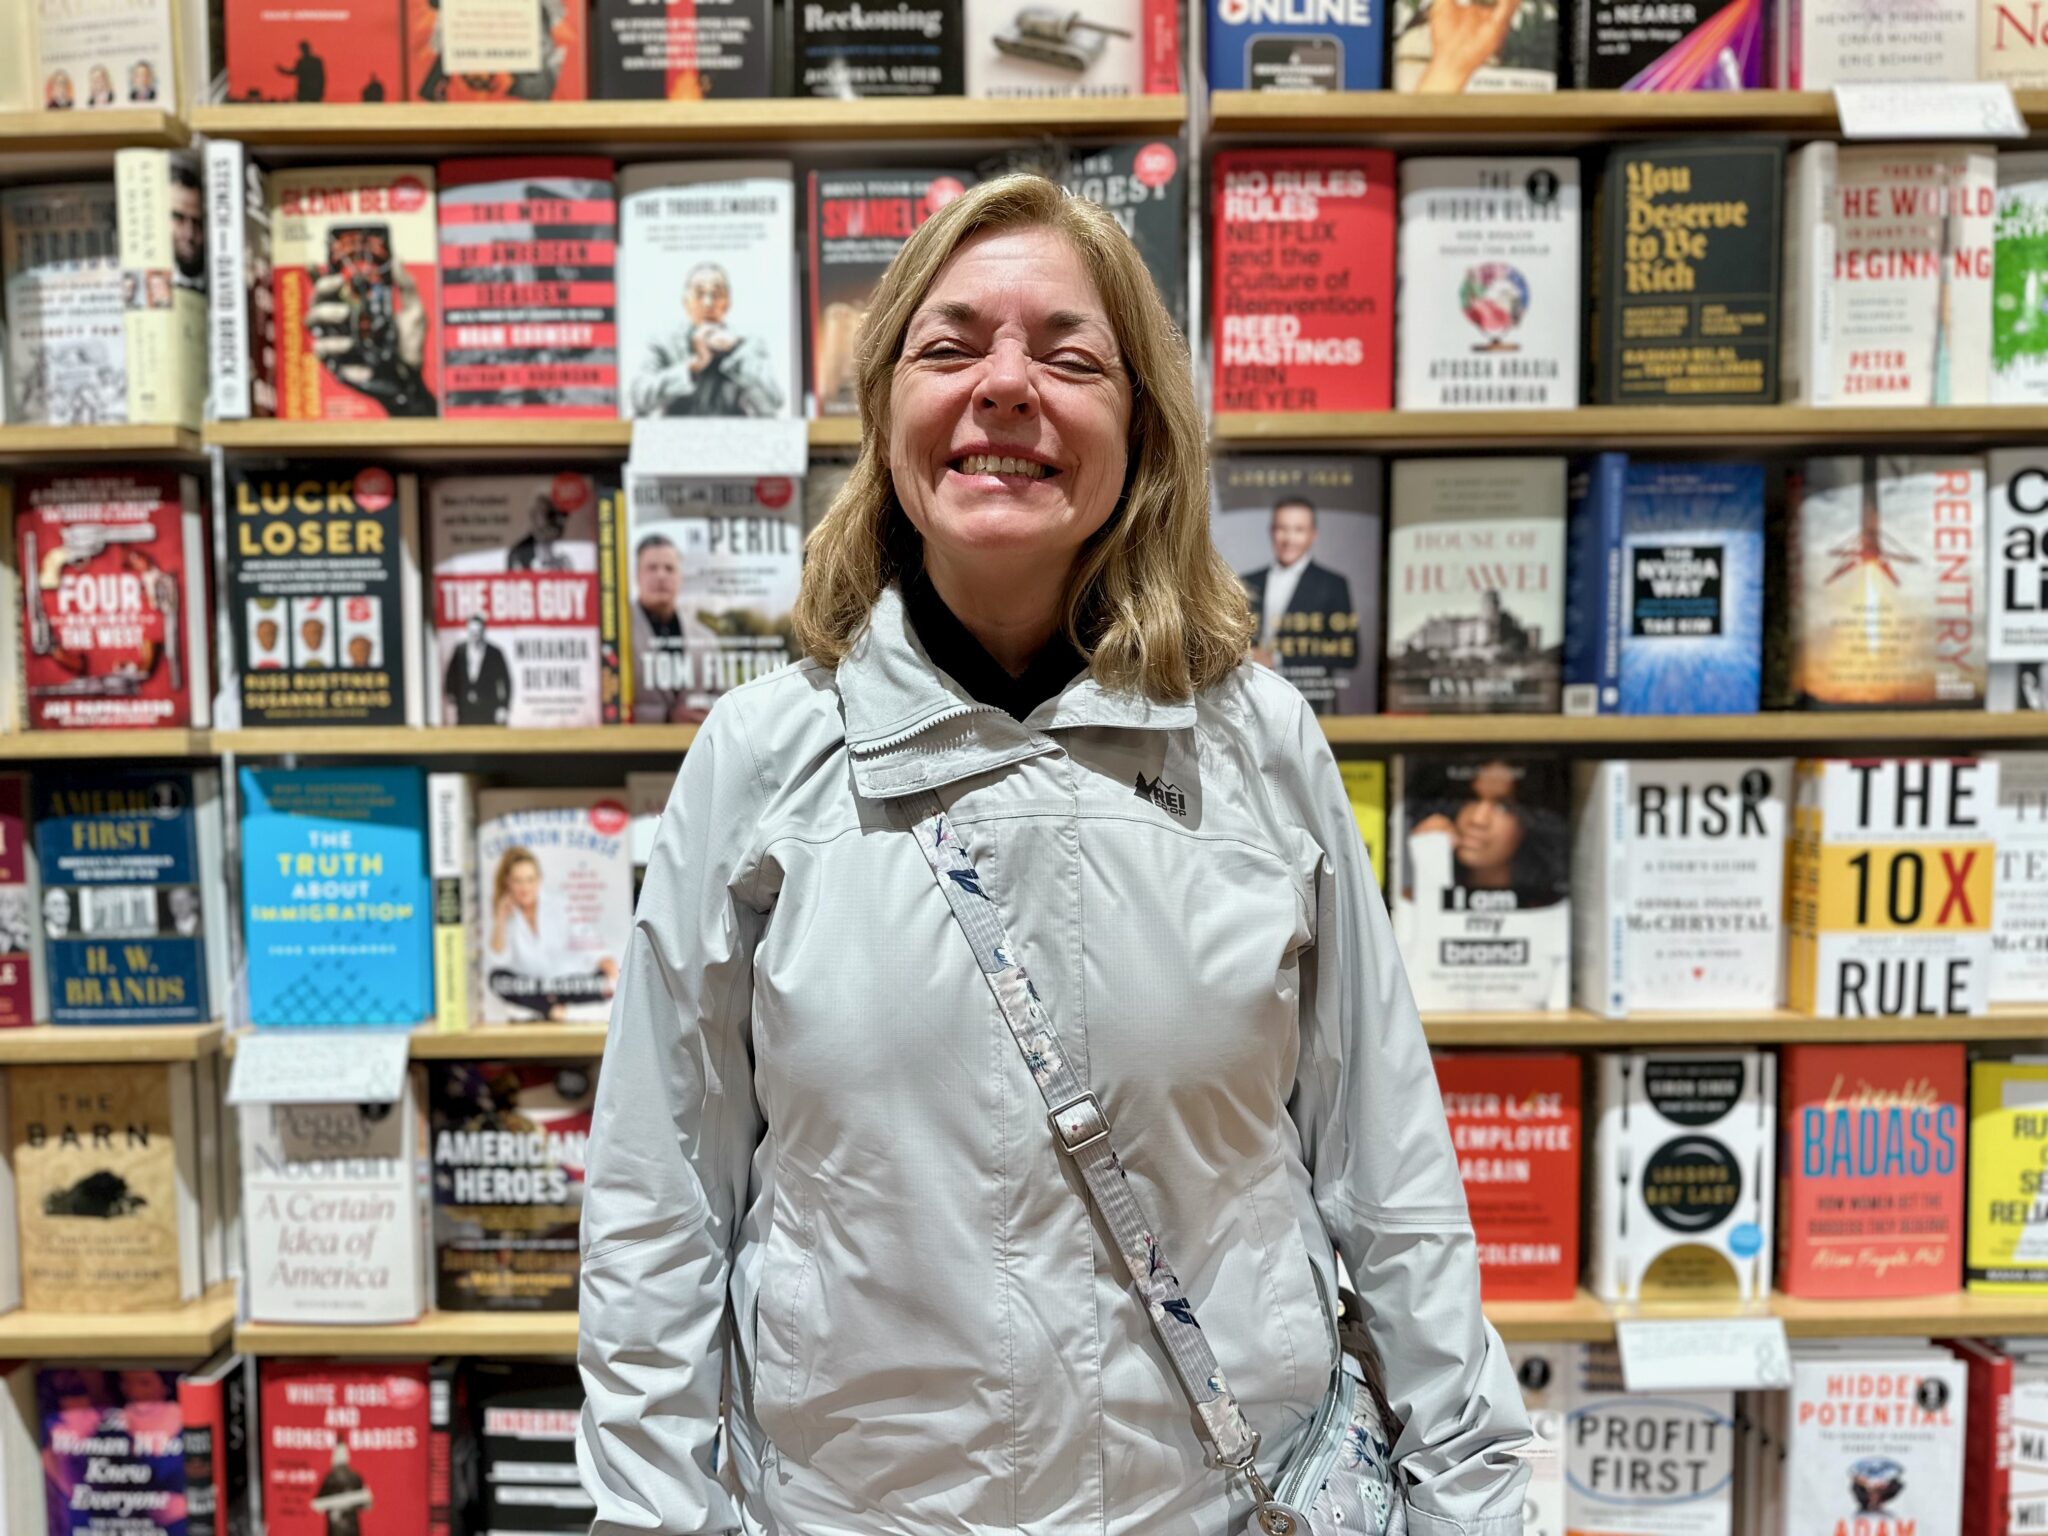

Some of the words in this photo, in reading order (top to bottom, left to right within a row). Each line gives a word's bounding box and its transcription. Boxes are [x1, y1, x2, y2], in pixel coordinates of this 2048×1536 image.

[804, 3, 943, 38] Reckoning
[1218, 0, 1372, 26] ONLINE
[1614, 3, 1697, 24] NEARER
[212, 157, 236, 228] STENCH
[1225, 170, 1268, 198] NO
[1272, 170, 1367, 198] RULES
[1479, 170, 1512, 191] THE
[1625, 161, 1692, 200] You
[281, 187, 353, 218] GLENN
[472, 205, 506, 222] THE
[517, 204, 574, 222] MYTH
[635, 199, 661, 219] THE
[667, 196, 780, 216] TROUBLEMAKER
[1224, 196, 1320, 222] RULES
[1426, 199, 1496, 223] HIDDEN
[1625, 199, 1749, 232] Deserve
[1225, 221, 1337, 244] NETFLIX
[1226, 247, 1275, 268] and
[1280, 247, 1321, 268] the
[1626, 233, 1660, 263] to
[1663, 229, 1708, 261] Be
[213, 256, 238, 312] DAVID
[1226, 269, 1318, 291] Culture
[1325, 268, 1351, 290] of
[1624, 260, 1696, 294] Rich
[1226, 294, 1376, 315] Reinvention
[511, 325, 594, 346] CHOMSKY
[1223, 315, 1301, 338] REED
[216, 317, 239, 376] BROCK
[1222, 338, 1364, 366] HASTINGS
[1849, 350, 1907, 371] PETER
[1224, 366, 1286, 386] ERIN
[1844, 374, 1912, 395] ZEIHAN
[1224, 387, 1317, 409] MEYER
[1228, 469, 1303, 487] ROBERT
[236, 480, 374, 515] LUCK
[238, 519, 385, 556] LOSER
[709, 520, 792, 556] PERIL
[1413, 529, 1497, 550] HOUSE
[1506, 528, 1540, 549] OF
[1404, 562, 1549, 595] HUAWEI
[1636, 559, 1720, 581] NVIDIA
[1934, 469, 1975, 674] REENTRY
[57, 573, 143, 613] FOUR
[441, 580, 489, 622] THE
[491, 579, 535, 621] BIG
[537, 579, 590, 621] GUY
[1650, 579, 1707, 598] WAY
[61, 627, 94, 649] THE
[96, 626, 144, 648] WEST
[514, 638, 589, 661] MIRANDA
[244, 672, 290, 690] RUSS
[293, 671, 390, 689] BUETTNER
[522, 666, 582, 690] DEVINE
[641, 652, 695, 691] TOM
[244, 691, 327, 709] SUSANNE
[329, 689, 393, 708] CRAIG
[1153, 787, 1187, 811] REI
[1848, 761, 1979, 829] THE
[1636, 783, 1769, 839] RISK
[71, 821, 154, 850] FIRST
[308, 830, 352, 849] THE
[276, 852, 384, 877] TRUTH
[291, 880, 371, 900] ABOUT
[1469, 889, 1519, 912] am
[1847, 849, 1979, 927] 10X
[252, 903, 414, 922] IMMIGRATION
[1465, 916, 1506, 936] my
[124, 945, 159, 974] W.
[1446, 940, 1523, 963] brand
[65, 976, 186, 1006] BRANDS
[1837, 958, 1972, 1018] RULE
[57, 1093, 112, 1113] THE
[1443, 1092, 1502, 1119] EVER
[26, 1122, 151, 1149] BARN
[435, 1130, 586, 1166] AMERICAN
[1454, 1125, 1572, 1151] EMPLOYEE
[1802, 1104, 1958, 1179] BADASS
[254, 1144, 397, 1180] Noonan
[1460, 1158, 1531, 1183] AGAIN
[454, 1168, 568, 1204] HEROES
[1646, 1186, 1683, 1206] EAT
[1686, 1185, 1737, 1206] LAST
[256, 1193, 281, 1222] A
[286, 1191, 396, 1222] Certain
[277, 1225, 340, 1255] Idea
[344, 1224, 379, 1259] of
[1477, 1244, 1562, 1265] COLEMAN
[268, 1259, 391, 1289] America
[285, 1383, 337, 1406] WHITE
[325, 1406, 361, 1428] AND
[1799, 1402, 1953, 1427] POTENTIAL
[51, 1428, 131, 1457] Woman
[133, 1431, 185, 1457] Who
[272, 1426, 338, 1449] BROKEN
[348, 1426, 418, 1450] BADGES
[1575, 1416, 1721, 1452] PROFIT
[85, 1457, 153, 1485] Knew
[1589, 1456, 1709, 1495] FIRST
[70, 1484, 173, 1518] Everyone
[1833, 1518, 1917, 1536] ADAM
